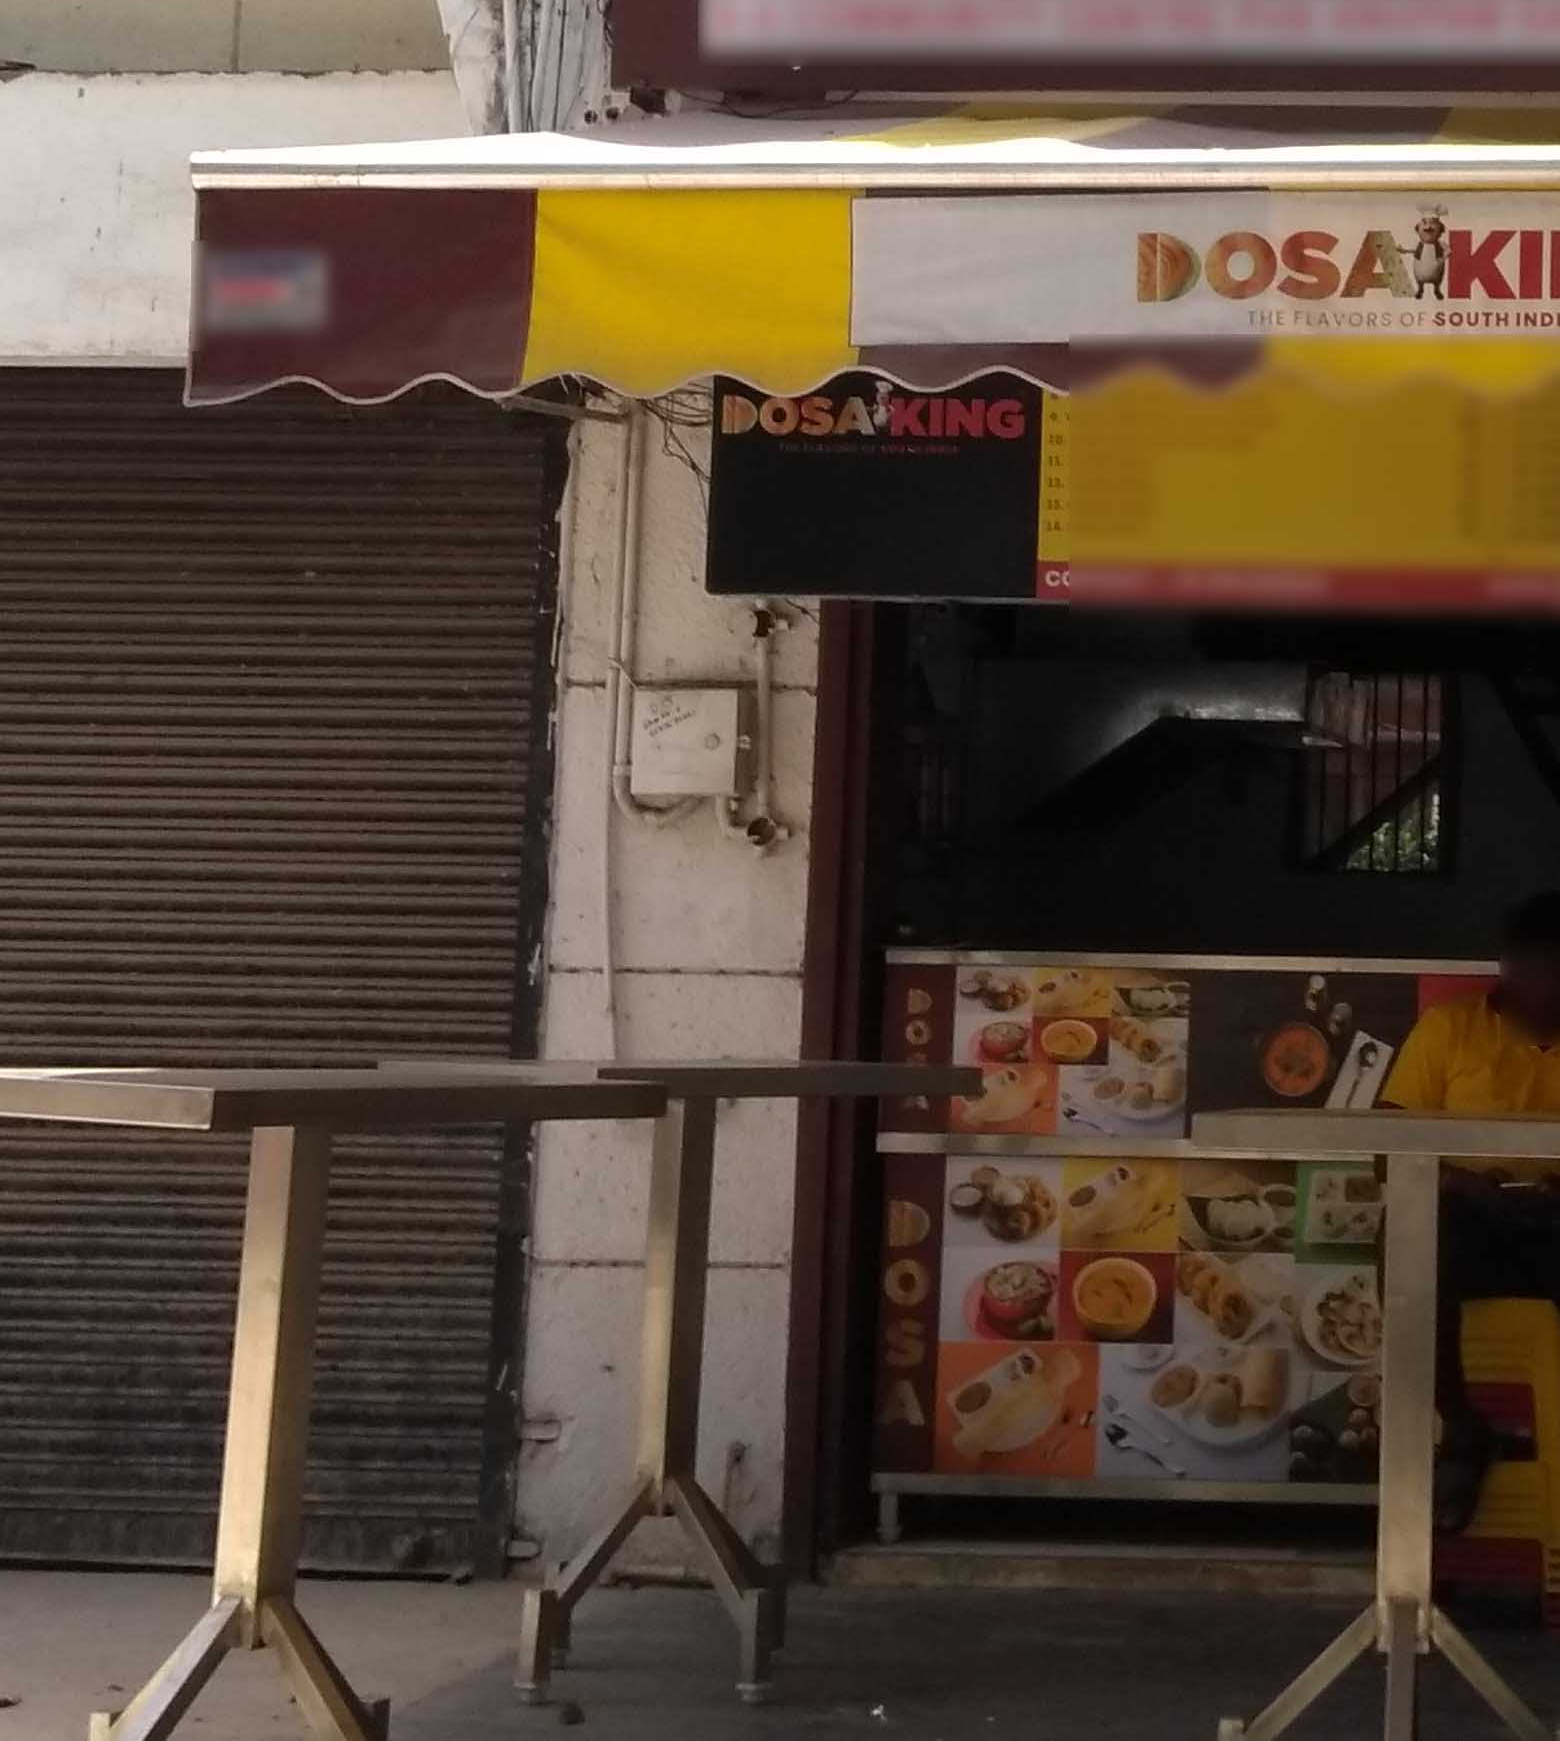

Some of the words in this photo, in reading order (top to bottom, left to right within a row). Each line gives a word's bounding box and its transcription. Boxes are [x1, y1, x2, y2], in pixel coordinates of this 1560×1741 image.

[1137, 230, 1416, 302] DOSA
[1247, 310, 1286, 326] THE
[1293, 310, 1393, 327] FLAVORS
[1399, 311, 1427, 327] OF
[1432, 312, 1509, 327] SOUTH
[721, 396, 877, 437] DOSA
[889, 397, 1026, 439] KING
[881, 1200, 931, 1427] DOSA
